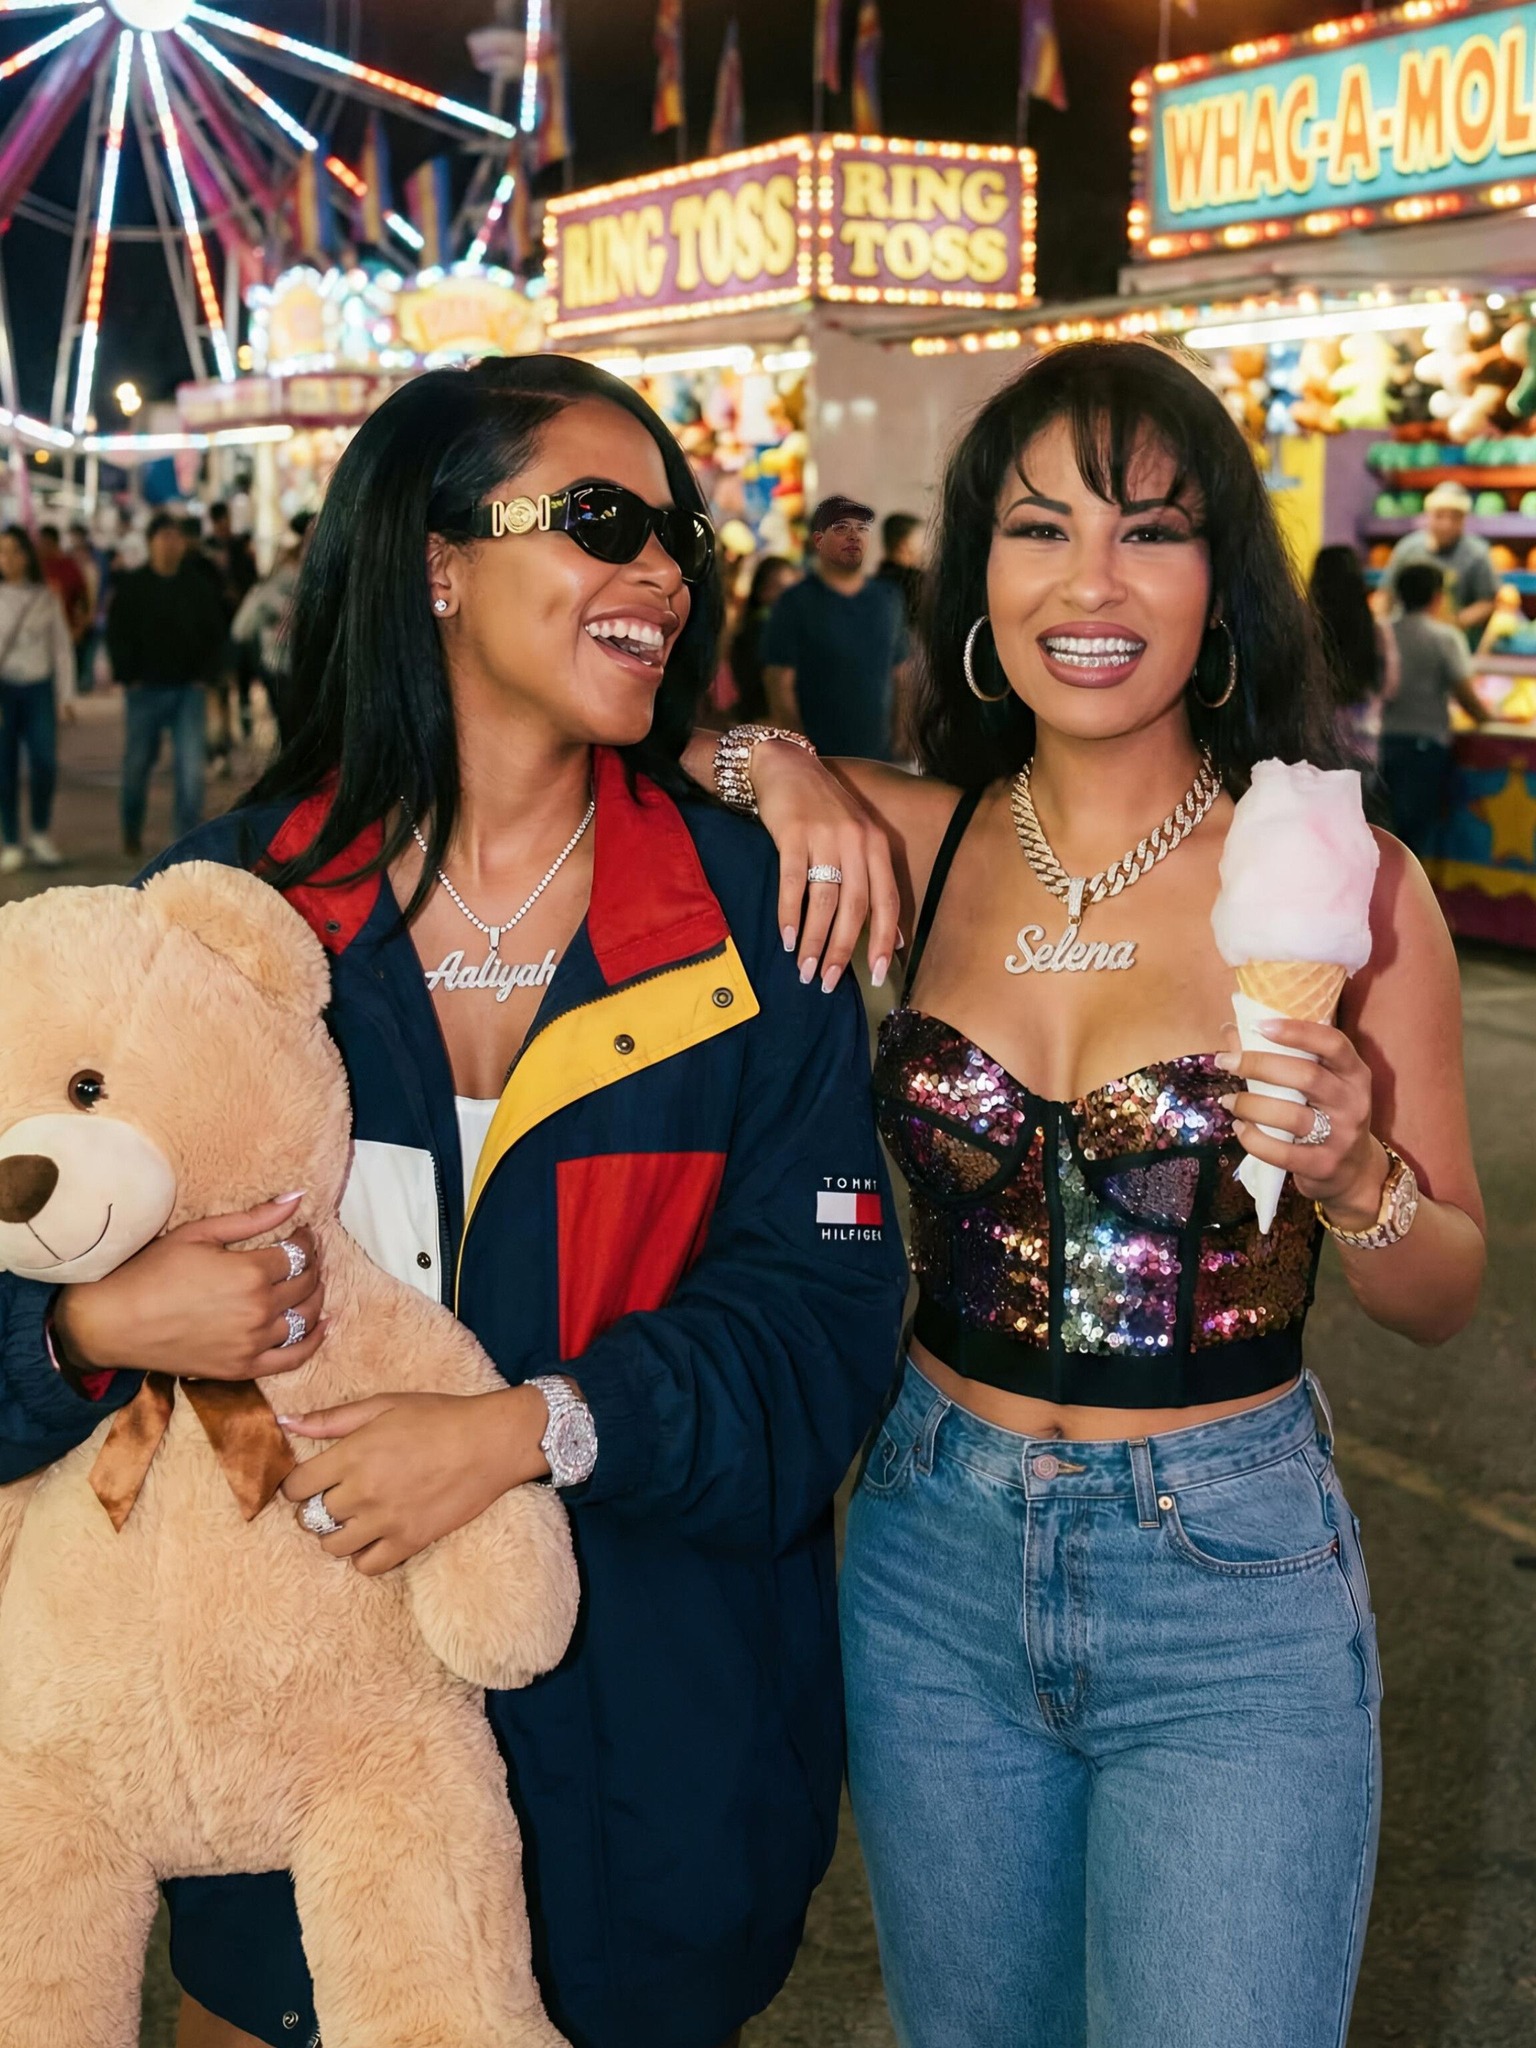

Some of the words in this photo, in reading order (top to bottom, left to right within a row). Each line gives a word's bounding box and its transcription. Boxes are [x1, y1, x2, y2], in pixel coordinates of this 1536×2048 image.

[1162, 26, 1536, 213] WHAC-A-MOL
[842, 162, 1008, 224] RING
[563, 204, 667, 309] RING
[670, 174, 798, 291] TOSS
[840, 221, 1008, 283] TOSS
[425, 948, 557, 1003] Aaliyah
[1004, 924, 1138, 975] Selena
